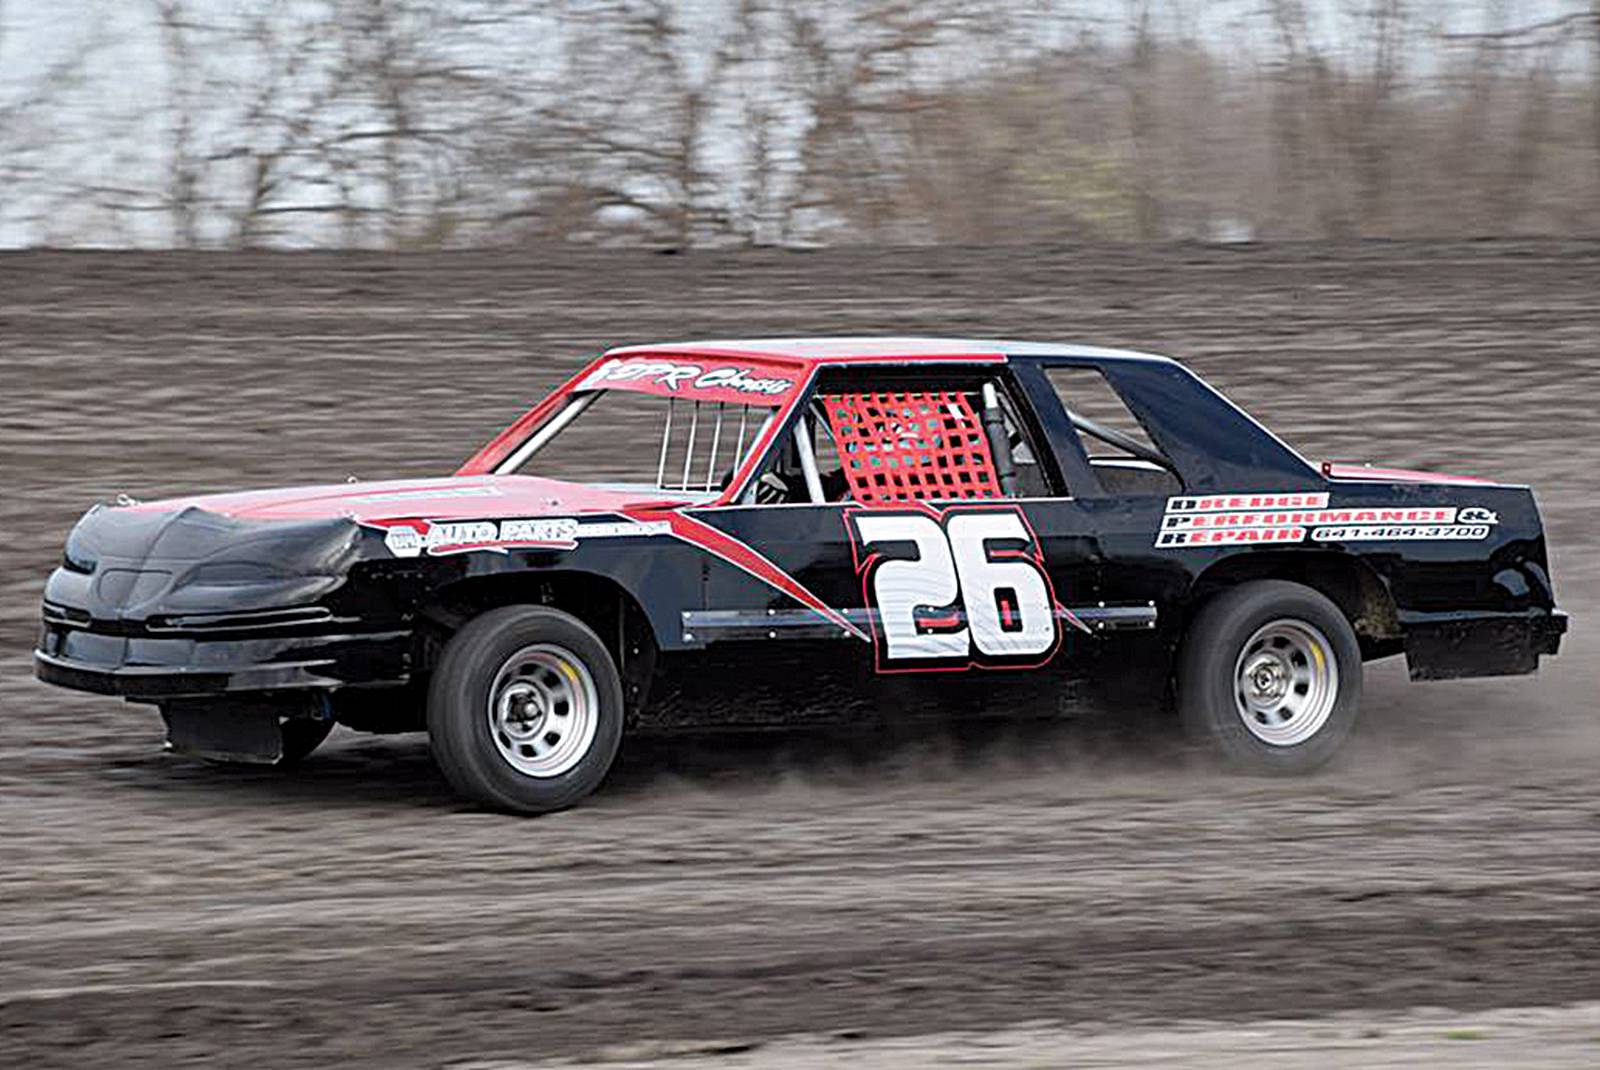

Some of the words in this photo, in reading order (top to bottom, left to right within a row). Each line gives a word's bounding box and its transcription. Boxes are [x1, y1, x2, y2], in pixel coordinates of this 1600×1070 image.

[1171, 495, 1325, 511] DREDGE
[1166, 510, 1451, 528] PERFORMANCE
[1460, 509, 1494, 523] &
[427, 522, 499, 543] AUTO
[500, 518, 579, 541] PARTS
[1160, 528, 1303, 545] REPAIR
[855, 513, 1055, 659] 26
